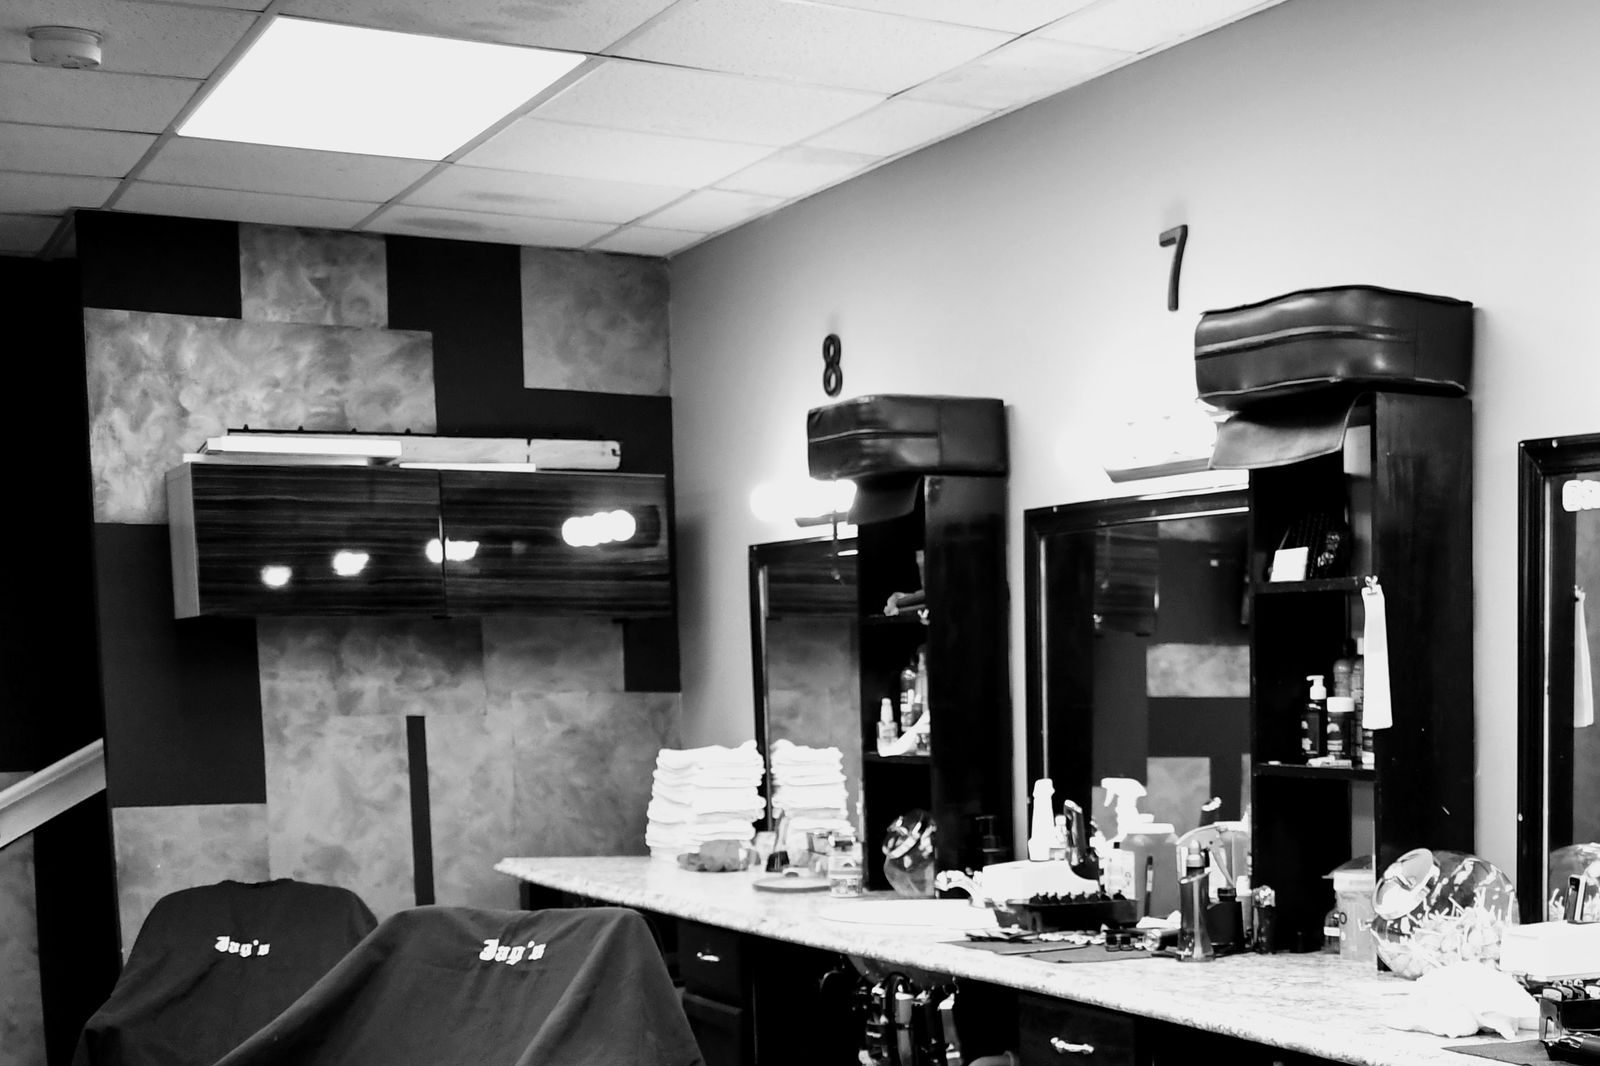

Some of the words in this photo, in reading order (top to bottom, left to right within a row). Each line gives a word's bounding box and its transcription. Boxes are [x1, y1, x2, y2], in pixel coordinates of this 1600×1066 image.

[1159, 224, 1189, 312] 7
[822, 333, 843, 398] 8
[479, 938, 547, 966] Jag's
